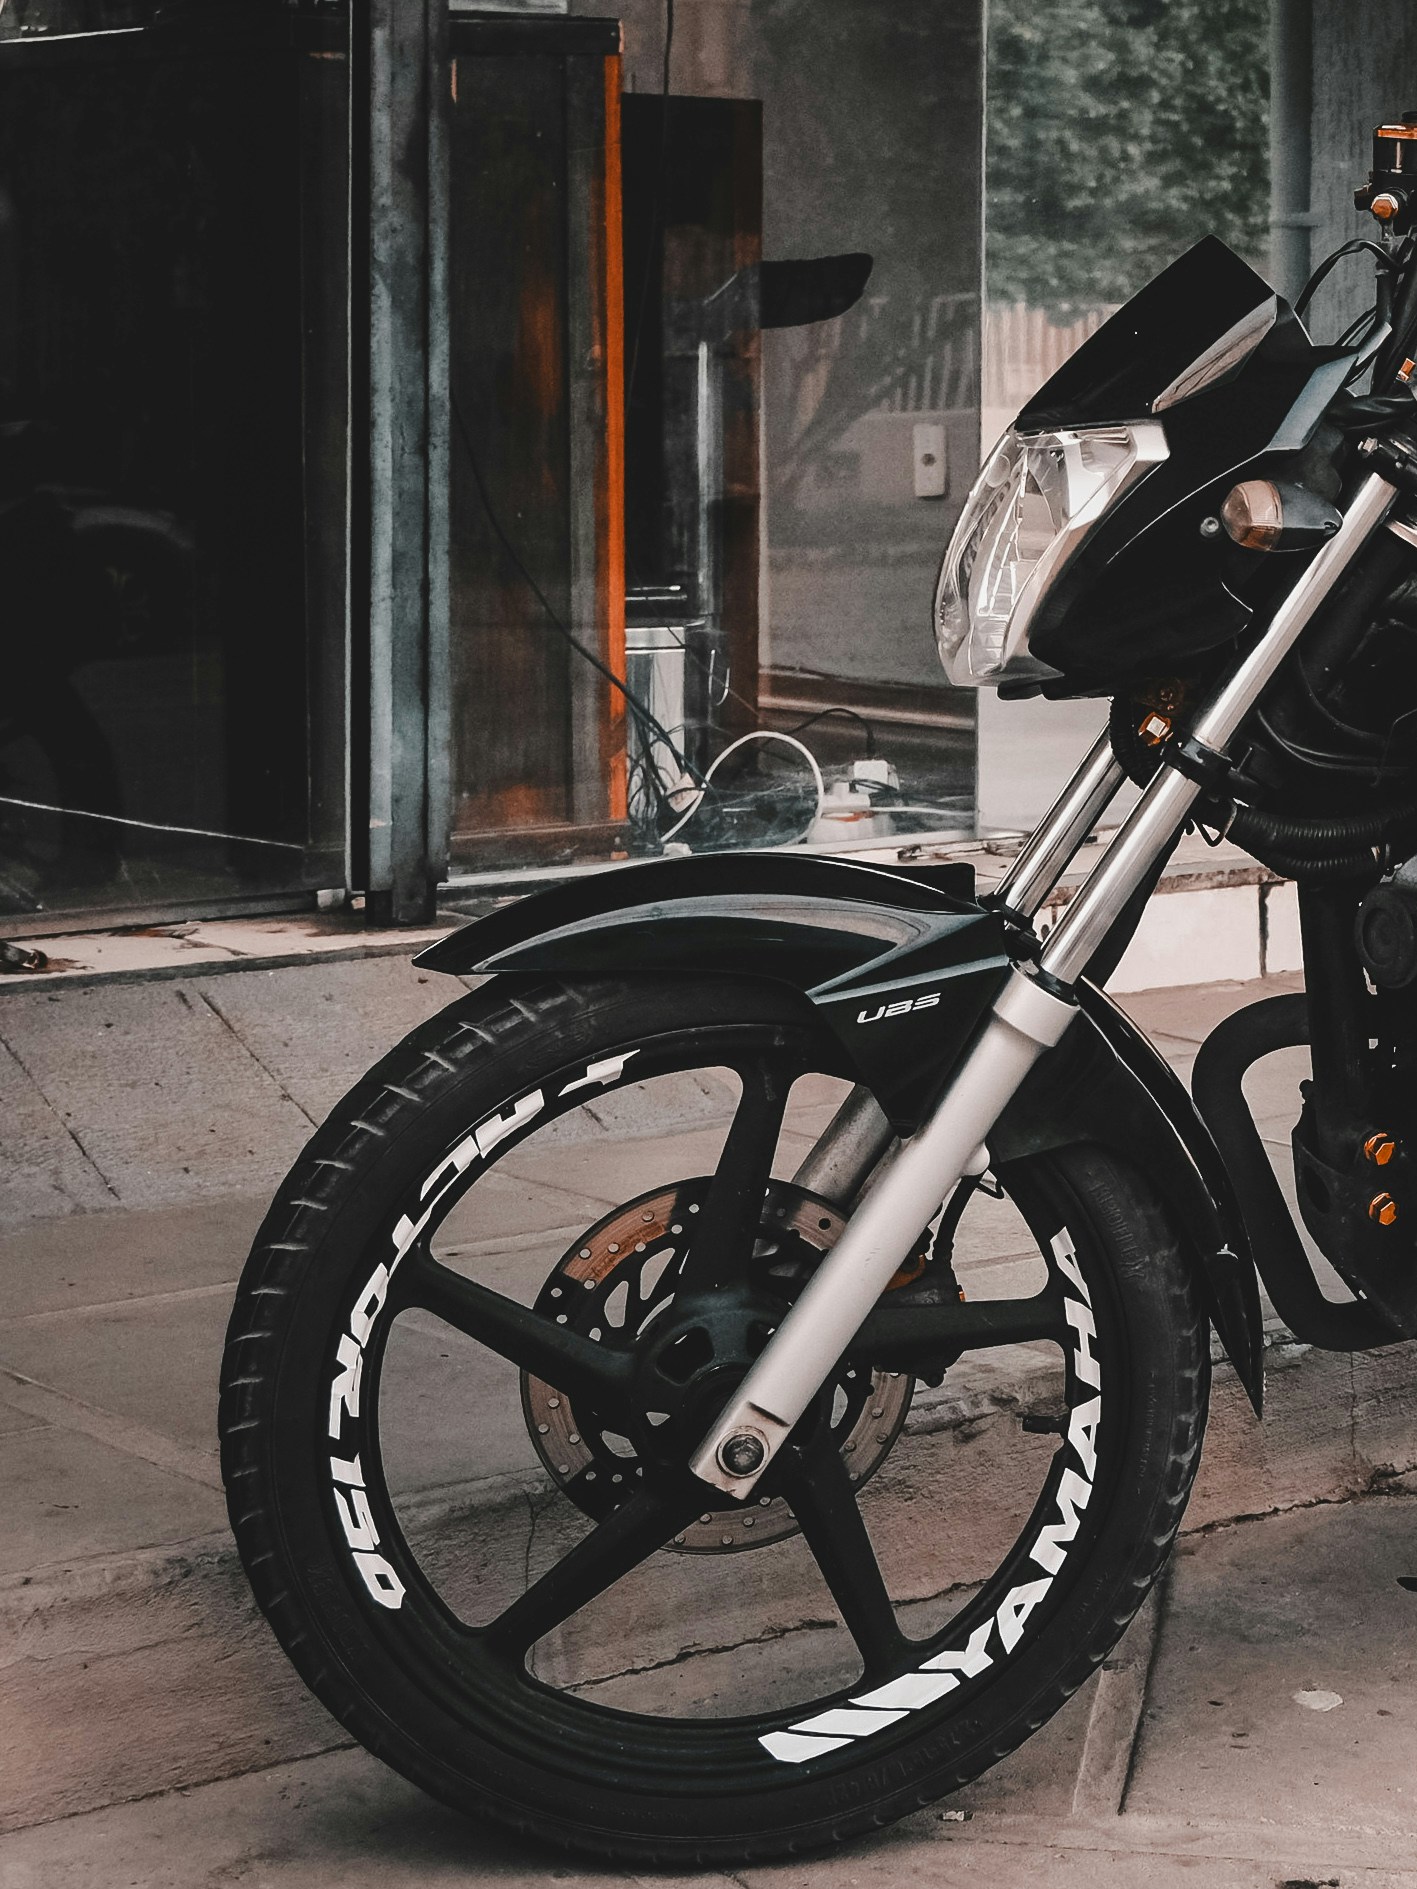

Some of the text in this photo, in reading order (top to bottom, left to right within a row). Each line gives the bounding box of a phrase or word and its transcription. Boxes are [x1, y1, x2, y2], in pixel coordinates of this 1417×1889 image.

[856, 992, 942, 1024] UBS
[328, 1452, 407, 1610] 150
[918, 1225, 1101, 1680] YAMAHA
